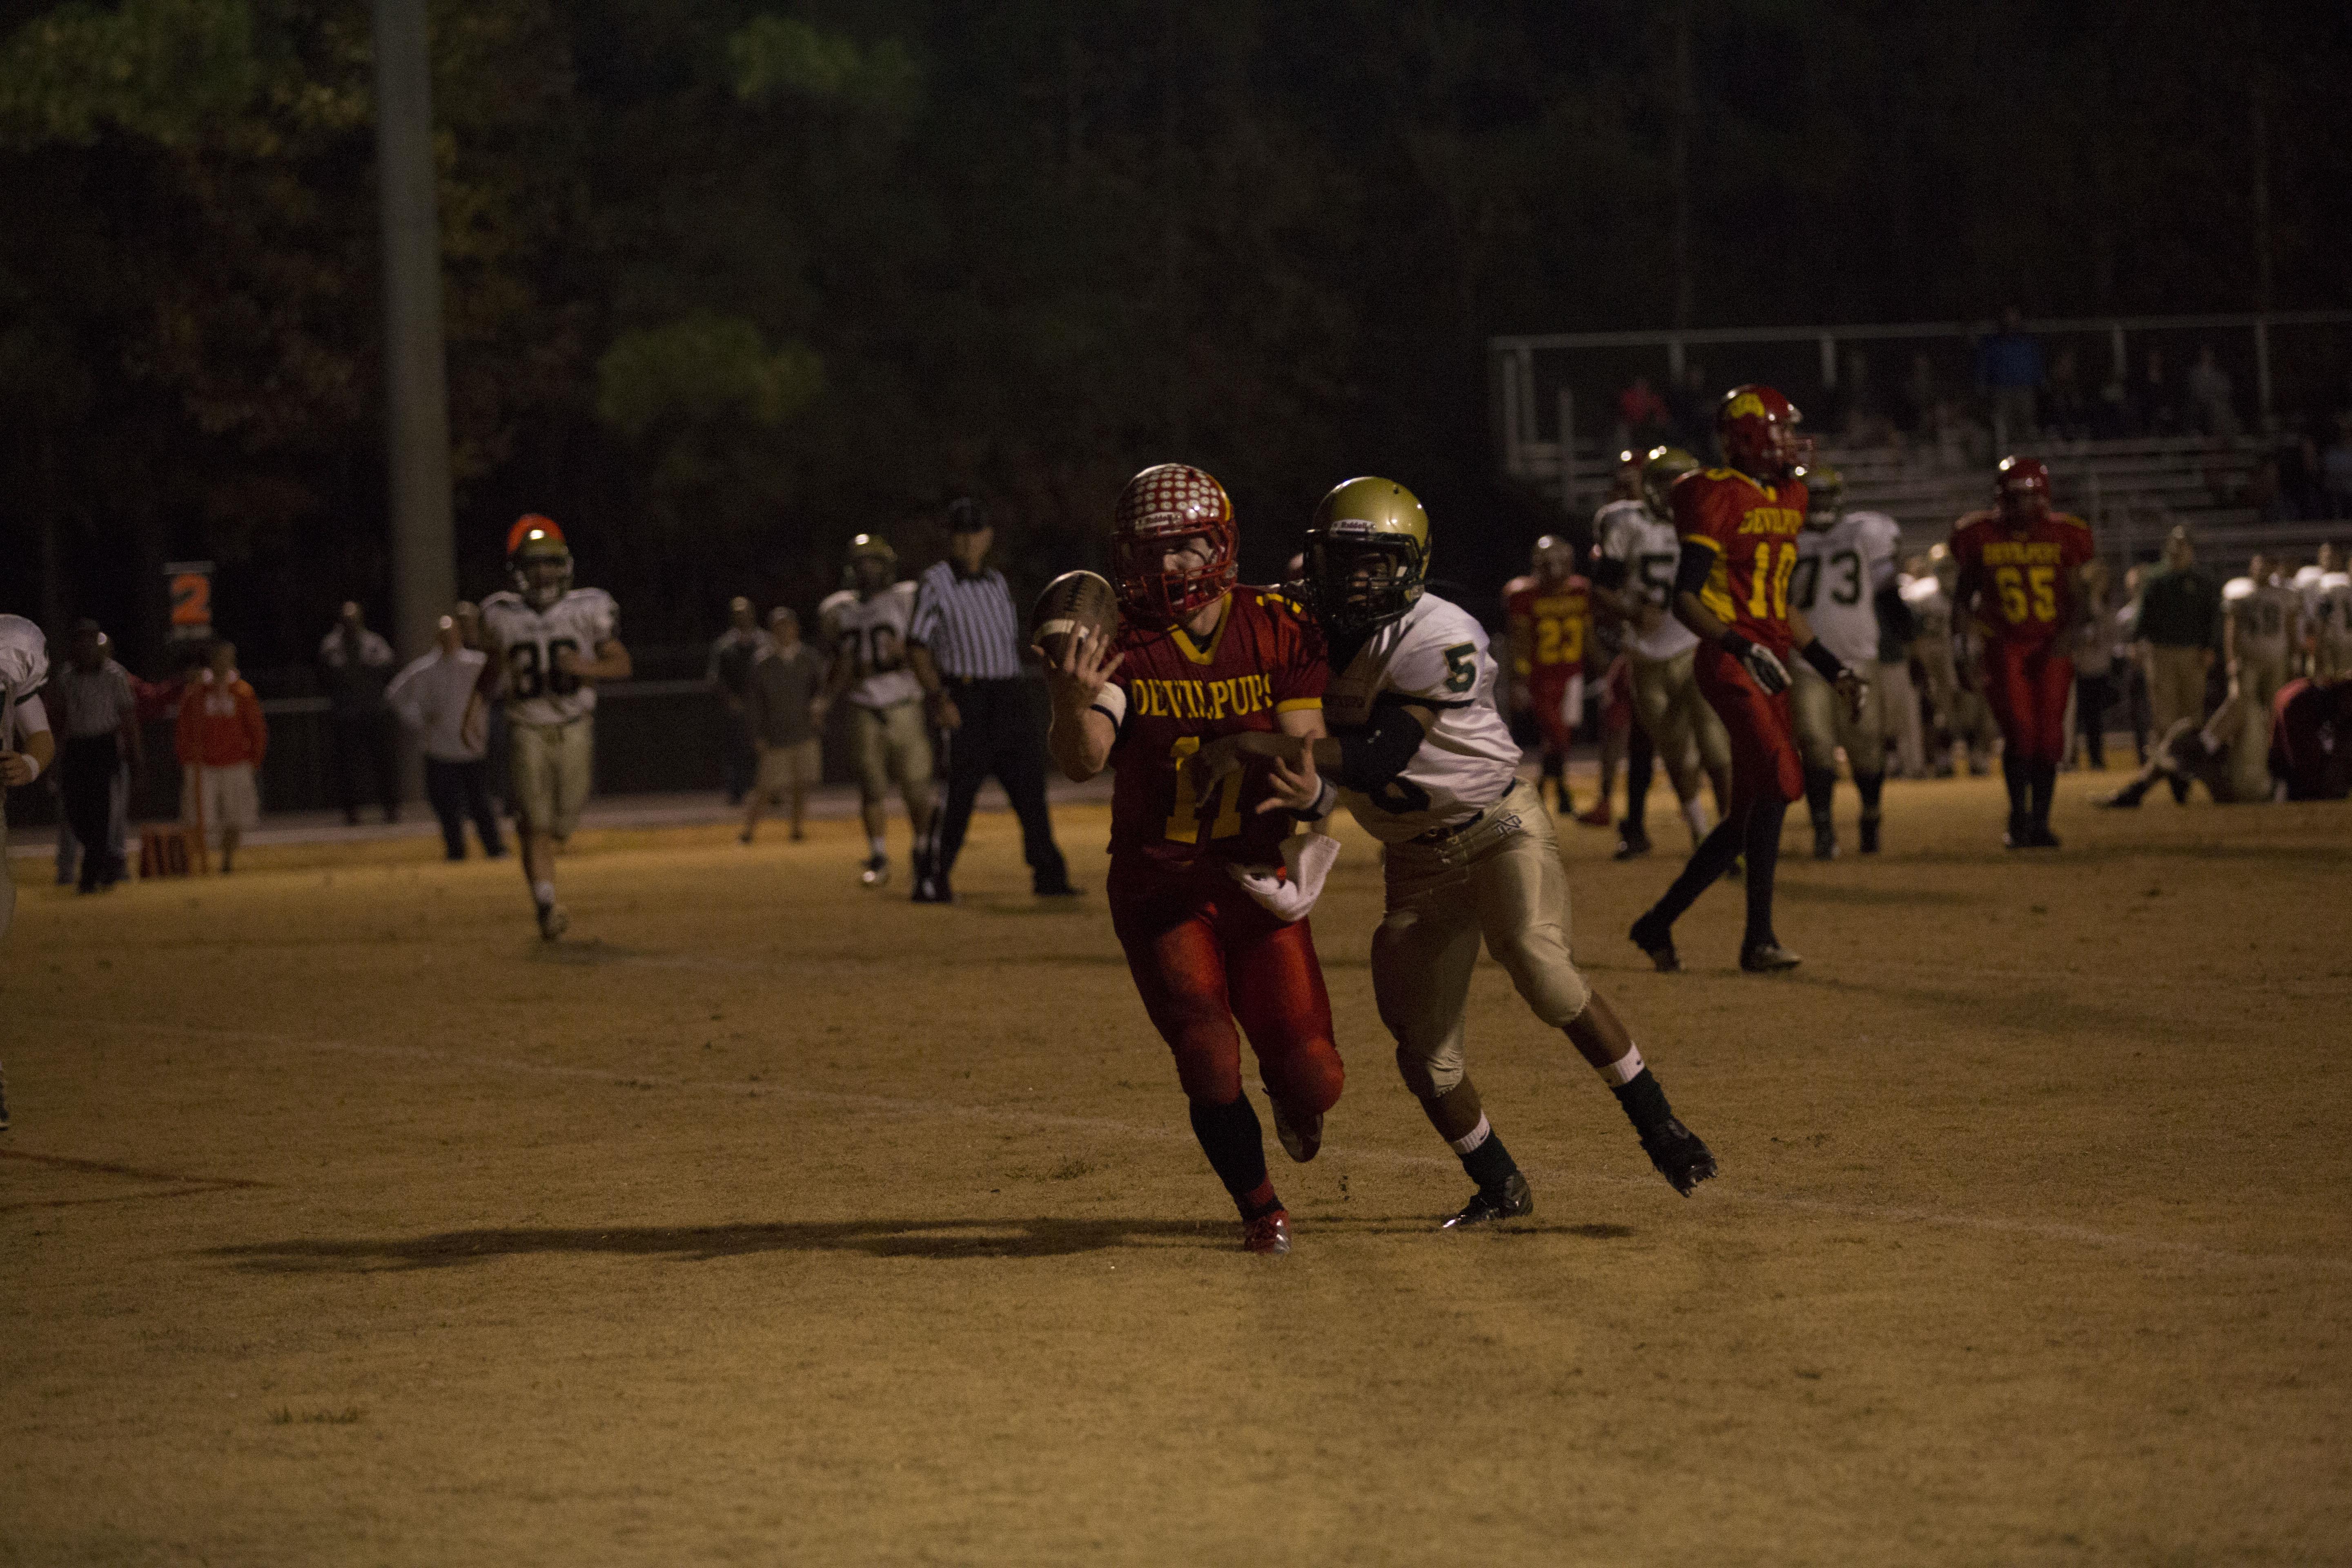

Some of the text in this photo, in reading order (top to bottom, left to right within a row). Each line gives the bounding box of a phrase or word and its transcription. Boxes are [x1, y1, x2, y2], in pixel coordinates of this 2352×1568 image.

[170, 572, 211, 626] 2
[1748, 541, 1797, 620] 10
[1442, 641, 1477, 693] 5
[1537, 616, 1584, 666] 23
